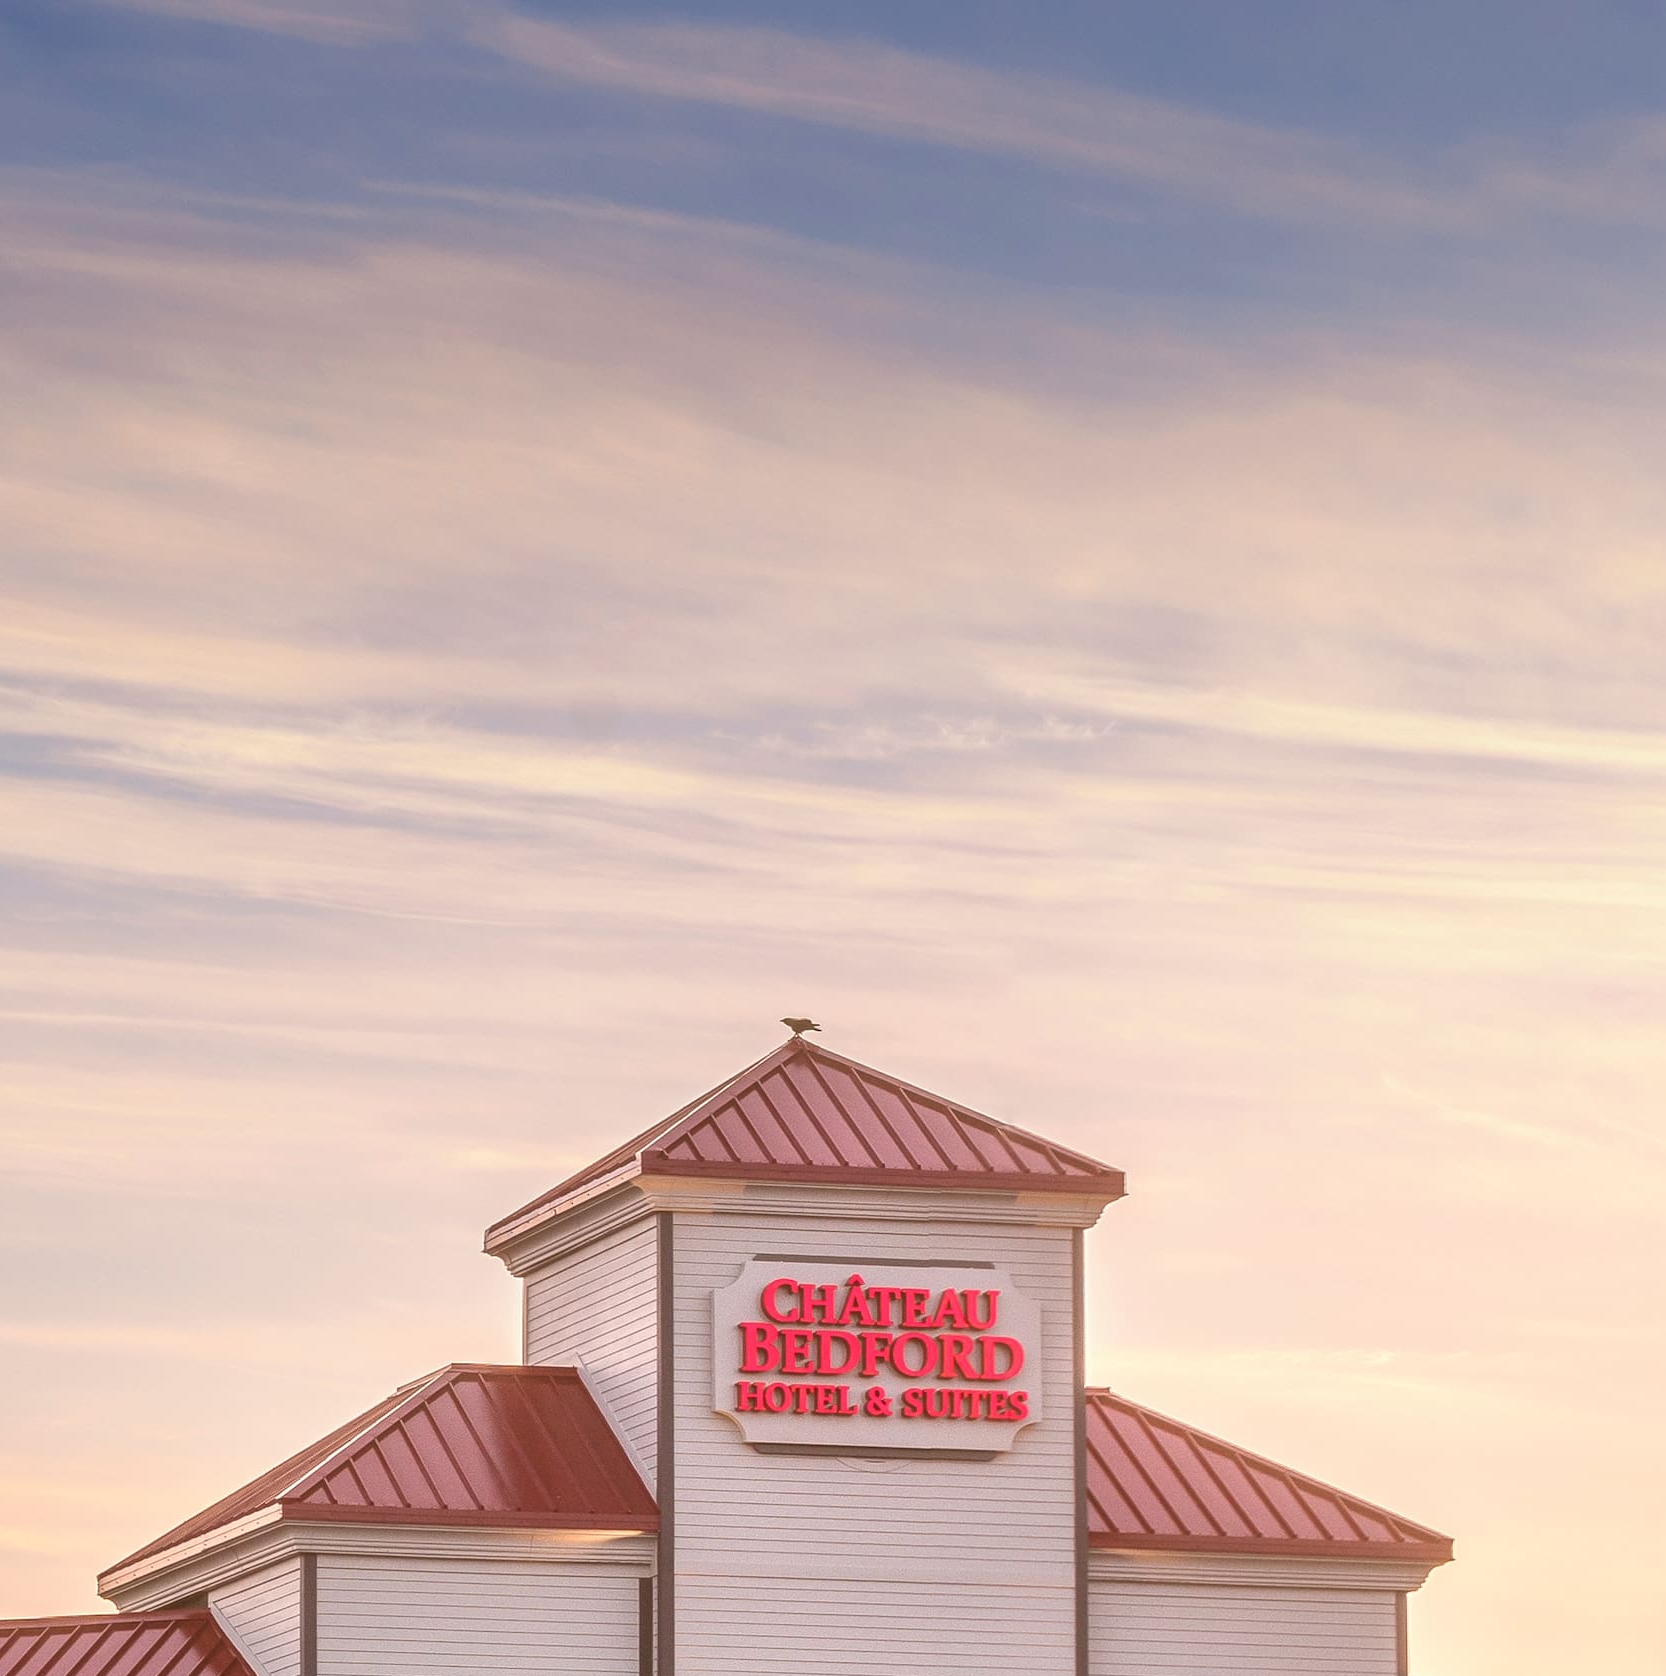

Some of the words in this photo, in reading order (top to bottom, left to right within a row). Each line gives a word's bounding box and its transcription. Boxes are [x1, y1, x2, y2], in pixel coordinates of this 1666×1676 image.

[760, 1273, 1000, 1330] CHÂTEAU
[738, 1321, 1025, 1381] BEDFORD
[735, 1381, 858, 1415] HOTEL
[865, 1386, 893, 1417] &
[901, 1388, 1029, 1421] SUITES
